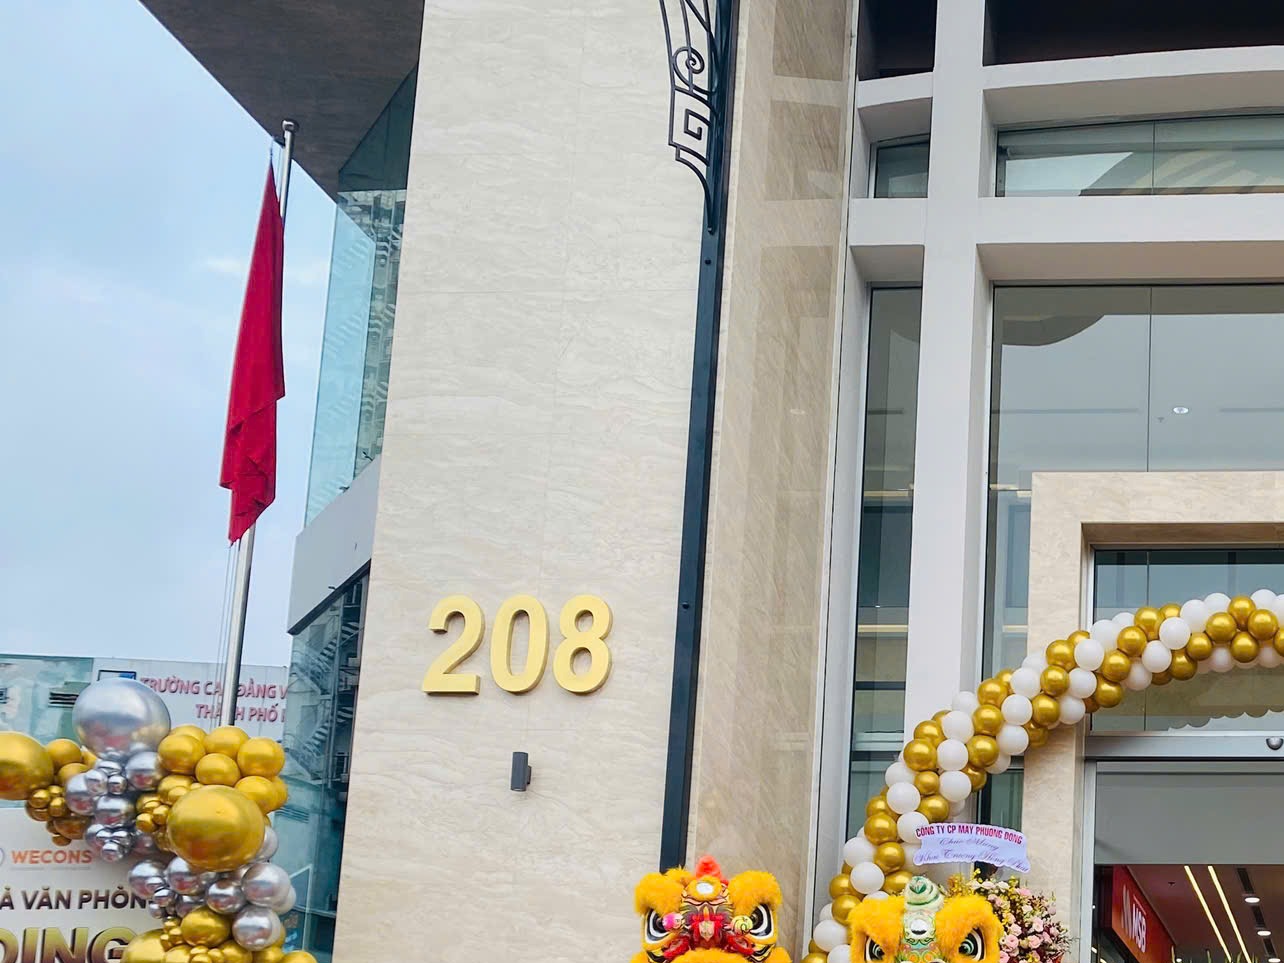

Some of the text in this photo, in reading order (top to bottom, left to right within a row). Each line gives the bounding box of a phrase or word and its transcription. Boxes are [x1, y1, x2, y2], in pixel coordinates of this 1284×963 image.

[421, 593, 614, 696] 208
[203, 681, 224, 697] CA
[936, 825, 945, 834] TY
[946, 824, 957, 834] CP
[958, 824, 974, 834] MAY
[11, 849, 94, 865] WECONS
[77, 886, 154, 910] PHÒN
[1132, 903, 1146, 953] MSB
